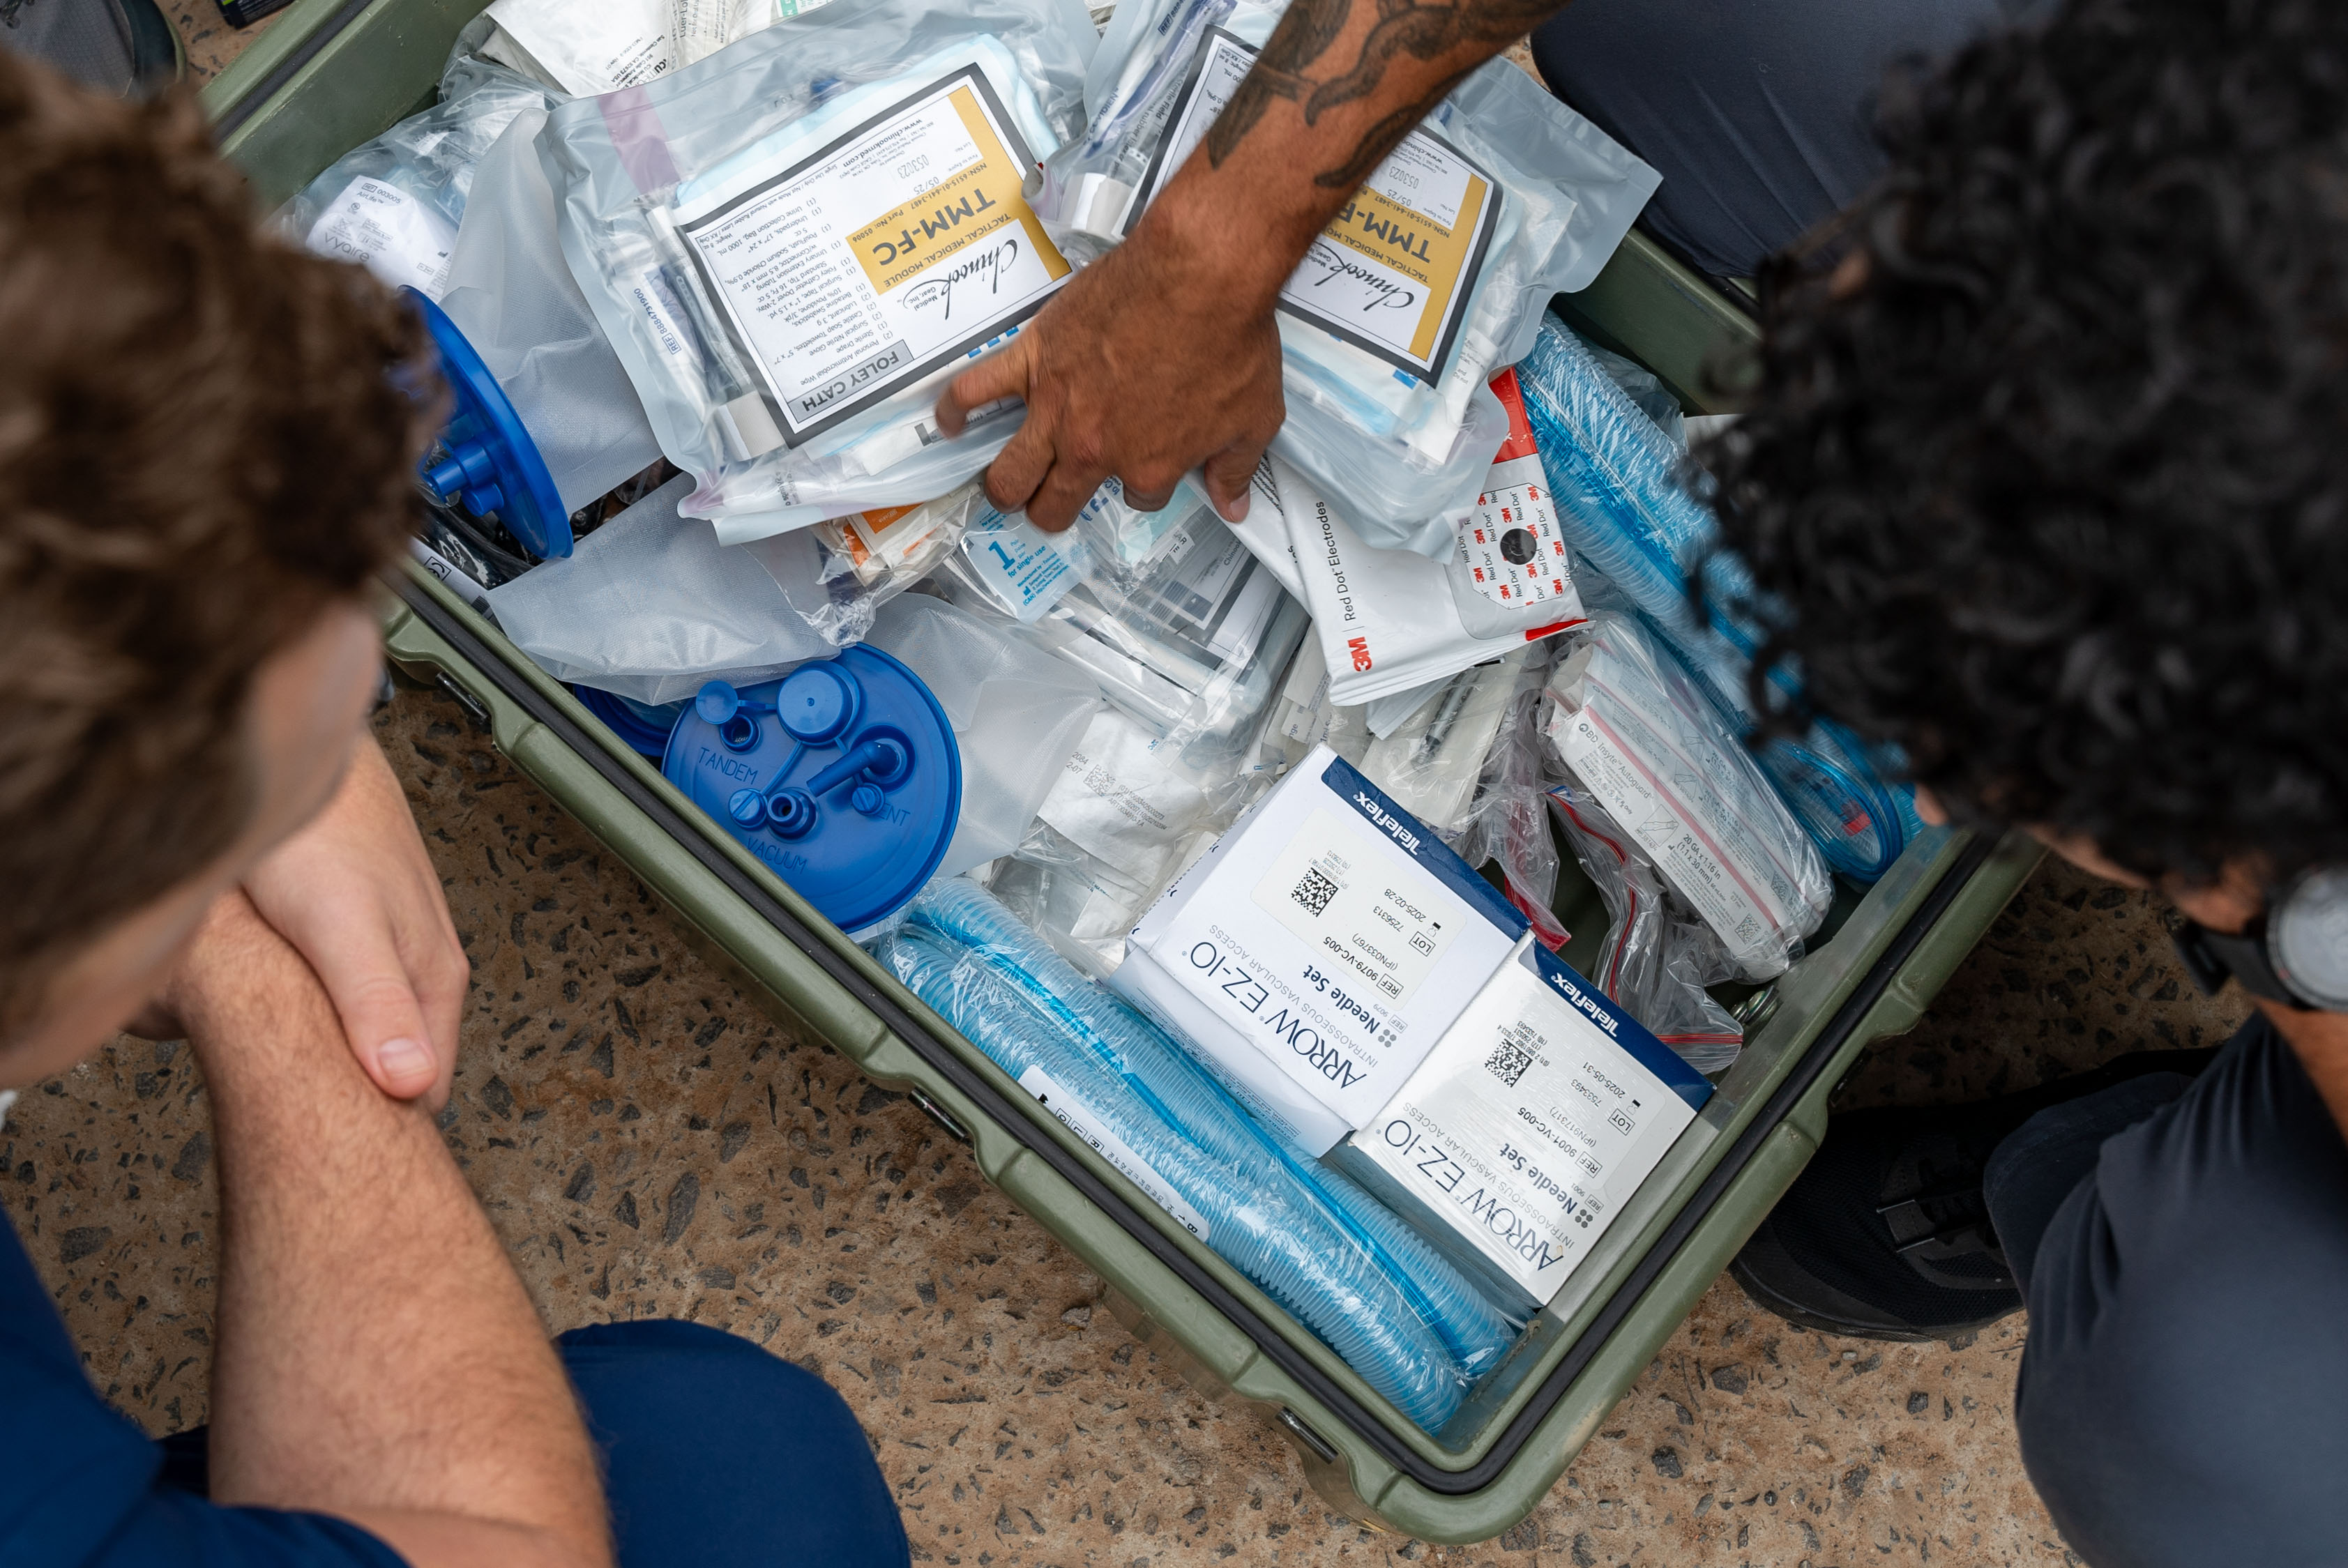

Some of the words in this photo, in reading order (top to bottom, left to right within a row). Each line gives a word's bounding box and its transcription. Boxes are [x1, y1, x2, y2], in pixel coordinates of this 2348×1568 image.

[842, 119, 923, 167] www.chinookmed.com
[897, 154, 930, 179] 053023
[967, 162, 987, 176] NSN:
[913, 176, 940, 195] 05/25
[1388, 165, 1420, 190] 053023
[377, 188, 402, 204] 003005
[910, 173, 968, 210] 6515-01-641-3487
[1386, 188, 1412, 207] 05/25
[806, 197, 817, 207] (1)
[785, 206, 803, 217] Urine
[887, 209, 904, 221] Part
[1374, 195, 1432, 228] 6515-01-641-3487
[757, 215, 786, 233] Collection
[872, 188, 997, 266] TMM-FC
[874, 218, 888, 229] No:
[964, 213, 1012, 241] TACTICAL
[1432, 224, 1451, 238] NSN:
[742, 230, 758, 241] Bag,
[852, 227, 874, 243] 05006
[716, 248, 728, 257] mL
[727, 238, 743, 252] 1000
[831, 240, 841, 250] (1)
[923, 237, 966, 264] MEDICAL
[1344, 234, 1384, 260] MEDICAL
[805, 249, 828, 263] Urinary
[840, 257, 851, 267] (1)
[775, 260, 805, 280] Extension
[821, 266, 837, 277] Foley
[883, 261, 924, 288] MODULE
[1385, 255, 1428, 284] TACTICAL
[755, 277, 778, 291] Tubing
[795, 274, 820, 291] Catheter
[855, 282, 866, 293] (1)
[777, 288, 795, 302] Dover
[825, 291, 852, 308] Betadine
[826, 287, 842, 298] 10%
[907, 296, 920, 304] Inc.
[918, 286, 937, 298] Gear,
[633, 288, 668, 335] 8884731900
[756, 298, 778, 313] 2-Way,
[798, 295, 828, 313] Povidone,
[914, 294, 938, 312] Medical
[783, 311, 799, 323] 3/pk
[791, 305, 826, 327] Swabsticks,
[872, 311, 882, 321] (2)
[877, 320, 888, 330] (1)
[844, 319, 869, 337] Surgical
[854, 329, 874, 343] Sterile
[883, 330, 893, 340] (2)
[665, 334, 679, 352] REF
[826, 333, 845, 347] Nitrile
[835, 340, 855, 353] Drape
[854, 339, 880, 357] Personal
[808, 344, 826, 356] Glove
[816, 353, 854, 379] Antimicrobial
[850, 351, 900, 387] FOLEY
[800, 374, 817, 386] Wipe
[801, 381, 847, 412] CATH
[1501, 508, 1511, 523] 3M
[1315, 501, 1341, 567] Electrodes
[1474, 528, 1485, 544] 3M
[987, 540, 1016, 571] 1
[1007, 568, 1017, 579] for
[1016, 554, 1035, 571] single
[1034, 545, 1046, 557] use
[1474, 568, 1484, 582] 3M
[1527, 563, 1537, 578] 3M
[1331, 568, 1349, 594] Dot™
[1500, 584, 1510, 599] 3M
[1339, 597, 1356, 621] Red
[1347, 637, 1372, 672] 3M
[698, 747, 759, 785] TANDEM
[1623, 805, 1633, 815] Only
[1640, 834, 1658, 852] 381434
[743, 835, 808, 876] VACUUM
[1683, 833, 1692, 845] 20
[1690, 842, 1700, 856] GA
[1703, 857, 1717, 873] 1.16
[1676, 842, 1690, 856] (1.1
[1690, 858, 1701, 869] 30
[1698, 867, 1713, 885] mm)
[1384, 888, 1427, 923] 2025-02-28
[1372, 906, 1404, 933] 7256313
[1209, 924, 1250, 960] ACCESS
[1323, 936, 1379, 981] 9079-VC-005
[1351, 933, 1398, 971] (IPN033767)
[1249, 958, 1301, 1006] VASCULAR
[1303, 964, 1330, 992] Set
[1331, 987, 1381, 1034] Needle
[1372, 1003, 1389, 1017] 9079
[1301, 1003, 1379, 1068] INTRAOSSEOUS
[1513, 1027, 1532, 1044] 250531
[1517, 1020, 1538, 1039] 7533493
[1530, 1040, 1542, 1051] (17)
[1536, 1035, 1548, 1046] (10)
[1582, 1061, 1626, 1099] 2025-05-31
[1570, 1079, 1602, 1108] 7533493
[1403, 1102, 1446, 1138] ACCESS
[1549, 1106, 1597, 1150] (IPN917317)
[1517, 1106, 1577, 1157] 9001-VC-005
[1444, 1136, 1497, 1185] VASCULAR
[1499, 1143, 1527, 1171] Set
[1528, 1166, 1578, 1215] Needle
[1570, 1182, 1586, 1197] 9001
[1498, 1181, 1575, 1249] INTRAOSSEOUS
